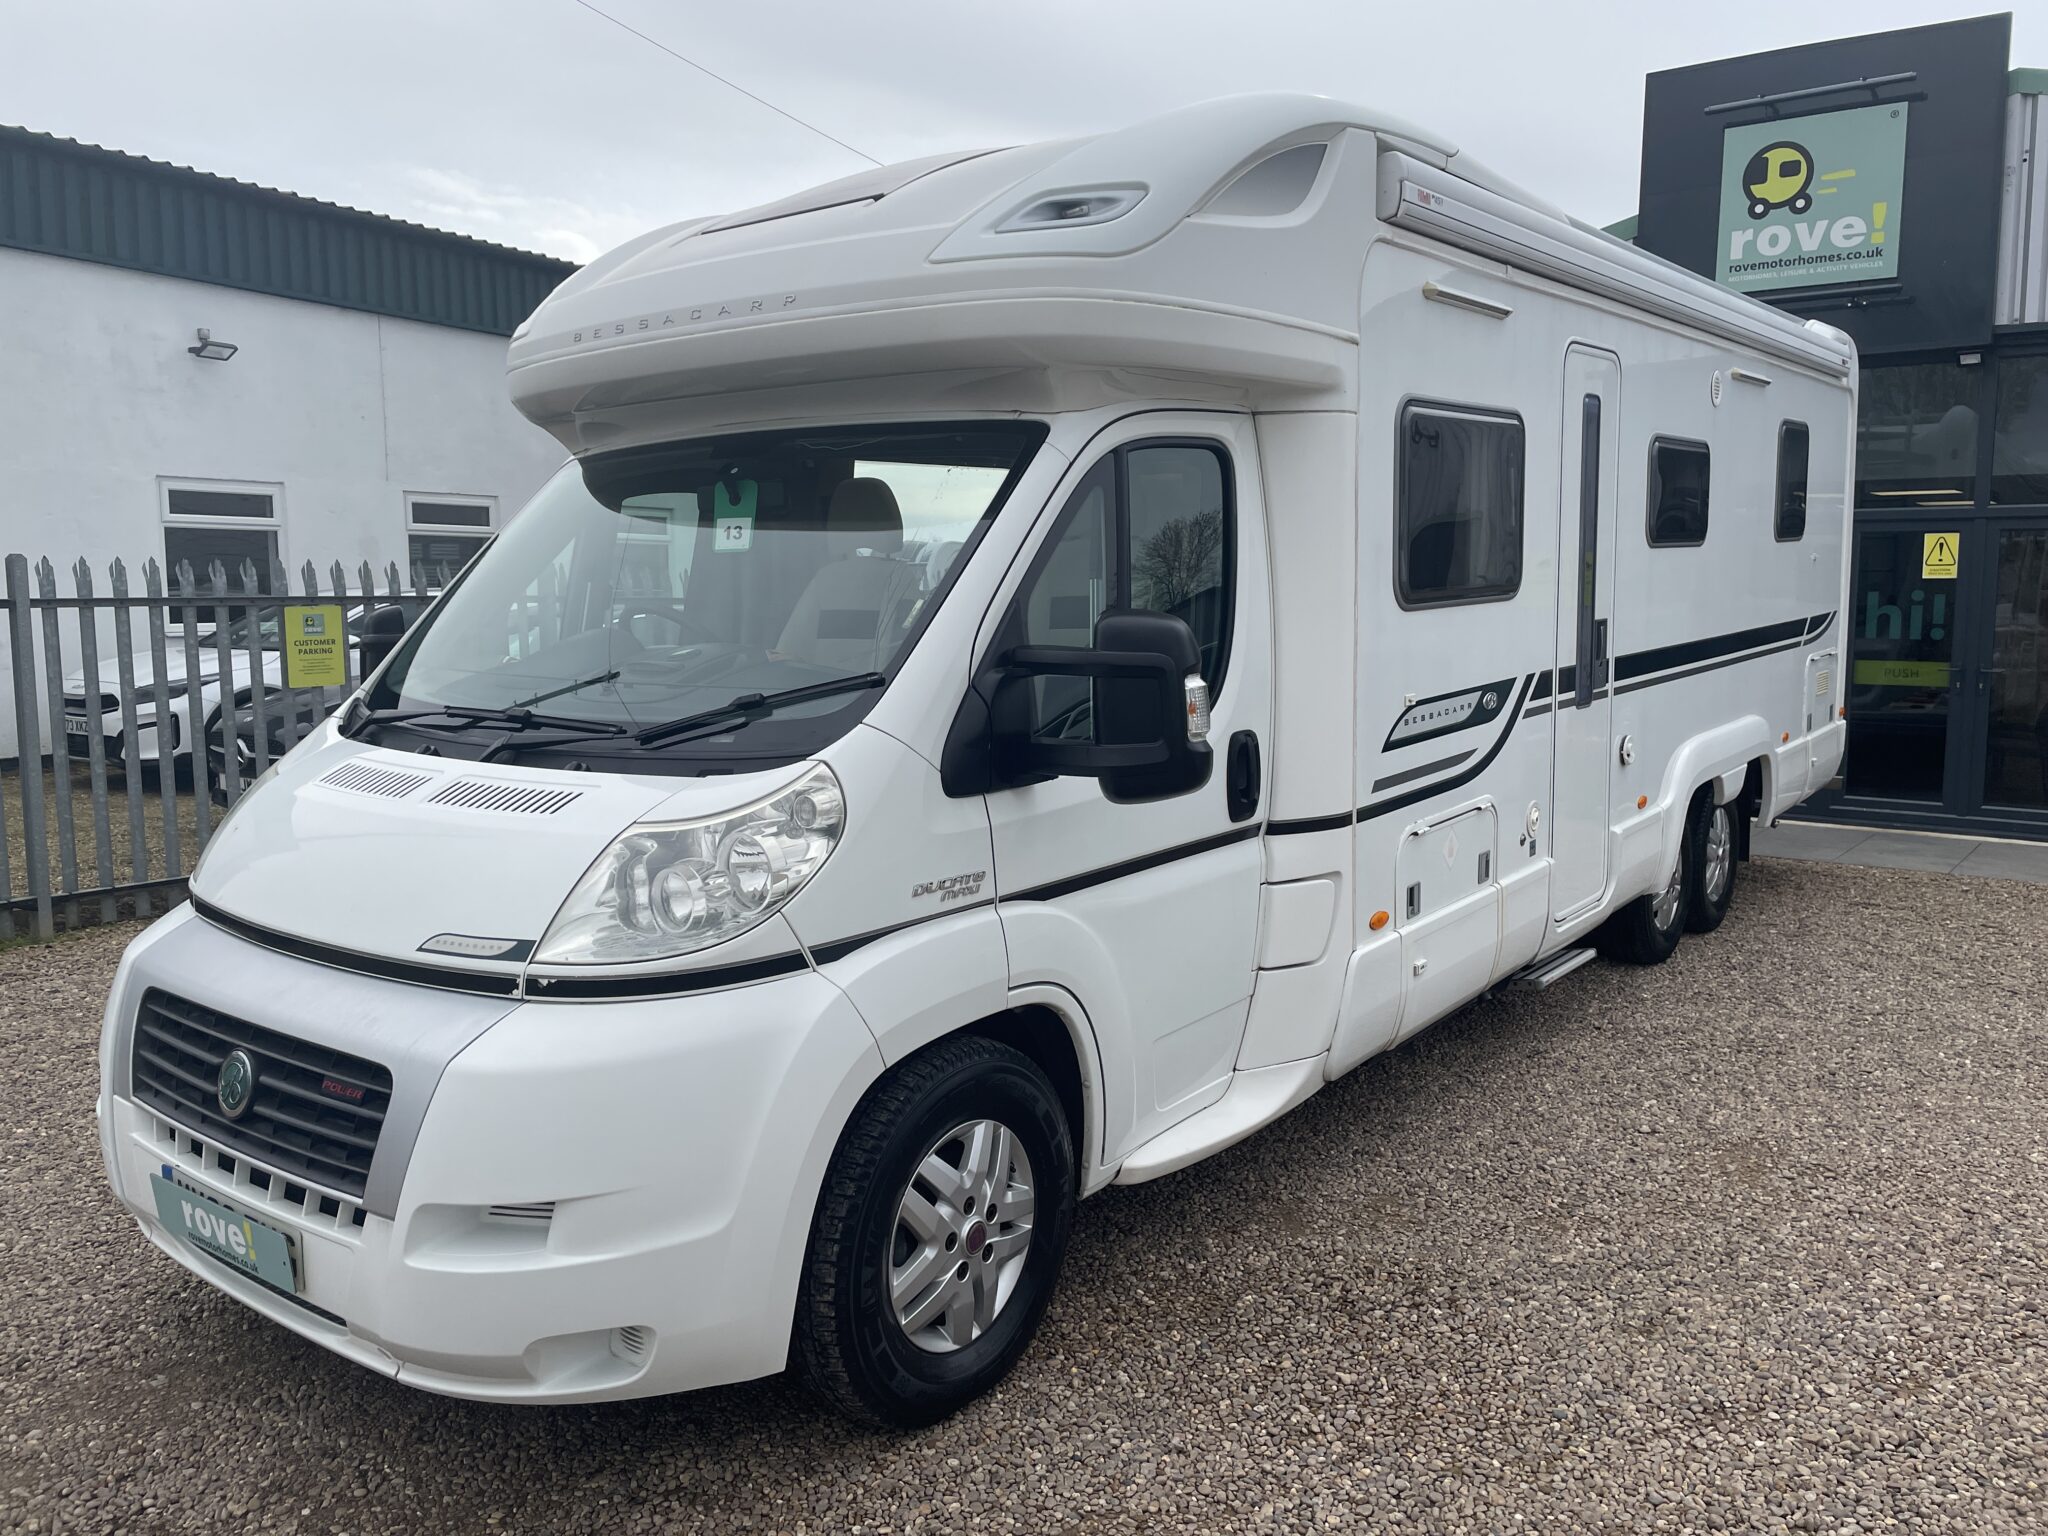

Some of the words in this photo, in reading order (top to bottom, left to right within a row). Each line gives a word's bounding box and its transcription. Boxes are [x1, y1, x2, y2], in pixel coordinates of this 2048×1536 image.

[1729, 202, 1887, 260] rove!
[1729, 246, 1883, 273] rovemotorhomes.co.uk
[1780, 267, 1807, 277] LEISURE
[1817, 264, 1848, 274] ACTIVITY
[1850, 260, 1883, 270] VEHICLES
[723, 525, 743, 540] 13
[1865, 589, 1946, 641] hi!
[294, 638, 336, 647] CUSTOMER
[298, 647, 333, 655] PARKING
[1884, 667, 1919, 678] PUSH
[912, 870, 986, 898] DUCATO
[940, 883, 981, 902] MAXI
[322, 1080, 364, 1099] POWER
[181, 1199, 257, 1261] rove!
[188, 1231, 260, 1274] rovemotorhomes.co.uk
